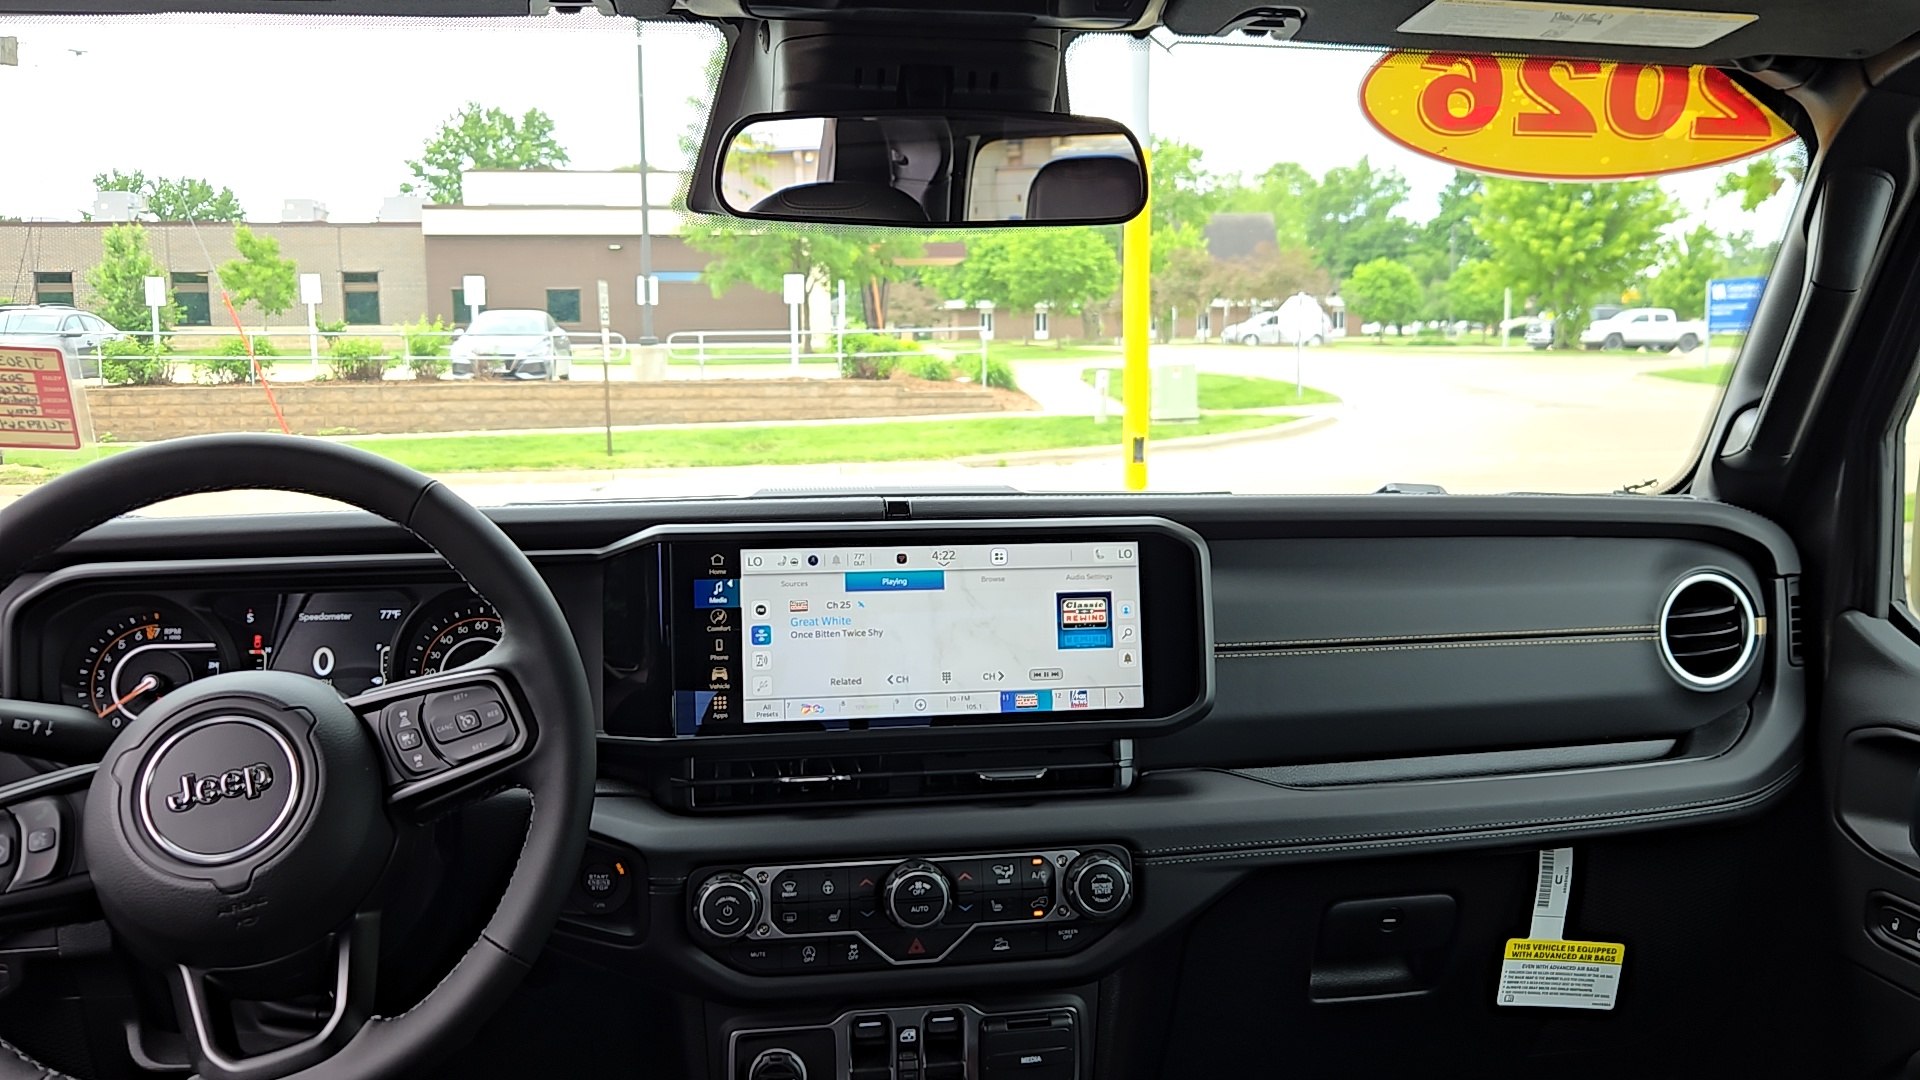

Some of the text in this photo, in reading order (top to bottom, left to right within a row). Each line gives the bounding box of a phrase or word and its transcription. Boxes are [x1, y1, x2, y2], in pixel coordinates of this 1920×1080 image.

[931, 550, 956, 561] 4:22
[1118, 549, 1133, 559] LO
[747, 556, 763, 567] LO
[882, 577, 908, 587] Playing
[1086, 573, 1113, 581] Settings
[826, 601, 852, 610] Ch 25
[1065, 601, 1104, 609] Classic
[246, 613, 255, 624] S
[299, 612, 353, 622] Speedometer
[790, 616, 852, 627] Great White
[1066, 614, 1105, 622] REWIND
[457, 625, 469, 634] 50
[474, 621, 489, 631] 60
[707, 625, 732, 633] Comfort
[134, 631, 143, 641] 6
[163, 627, 182, 636] RPM
[790, 628, 884, 639] Once Bitten Twice Shy
[117, 640, 127, 650] 5
[440, 635, 453, 645] 40
[103, 653, 112, 663] 4
[430, 651, 441, 660] 30
[312, 646, 336, 677] 0
[97, 669, 106, 680] 3
[424, 668, 437, 677] 20
[983, 673, 996, 681] CH
[830, 677, 862, 686] Related
[896, 675, 909, 684] CH
[709, 682, 731, 690] Vehicle
[95, 687, 105, 698] 2
[762, 703, 772, 711] All
[712, 711, 729, 720] Apps
[756, 710, 779, 718] Presets
[111, 717, 122, 729] 0
[436, 722, 454, 733] CANC
[166, 762, 274, 813] Jeep
[1031, 870, 1047, 880] A/C
[1555, 874, 1563, 885] U
[912, 888, 926, 896] OFF
[910, 905, 929, 913] AUTO
[1513, 942, 1531, 951] THIS
[1532, 943, 1566, 952] VEHICLE
[1577, 945, 1618, 955] EQUIPPED
[1511, 950, 1533, 958] WITH
[1533, 952, 1577, 960] ADVANCED
[1593, 954, 1616, 962] BAGS
[1020, 1055, 1043, 1064] MEDIA
